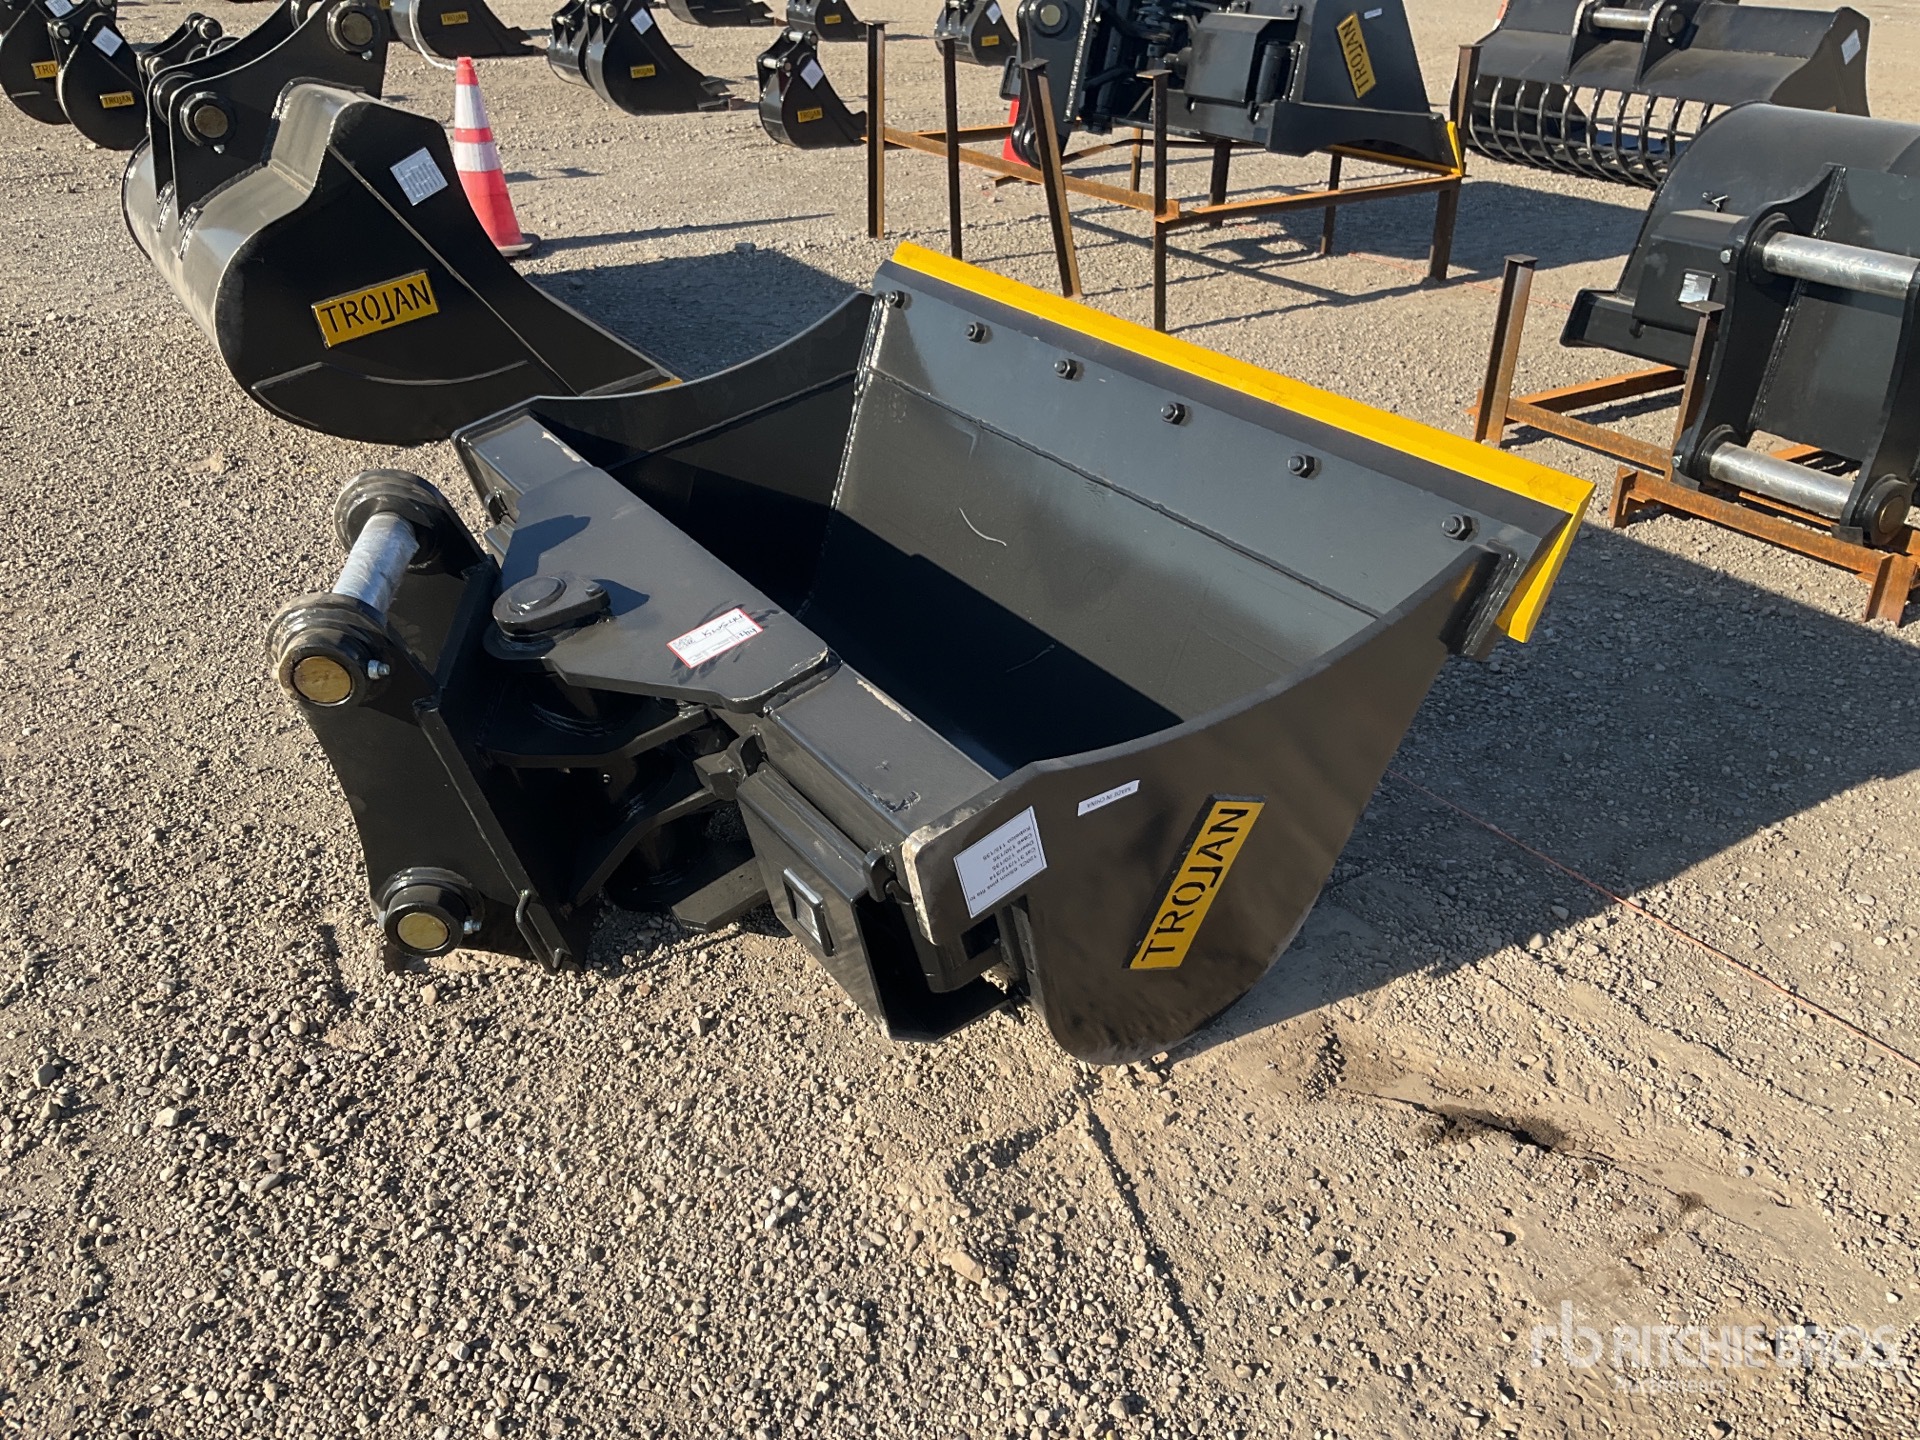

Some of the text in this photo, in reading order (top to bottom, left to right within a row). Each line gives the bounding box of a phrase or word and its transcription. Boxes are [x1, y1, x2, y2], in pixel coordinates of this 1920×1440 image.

[1342, 20, 1369, 93] TROJAN
[103, 96, 133, 106] TROJAN
[321, 280, 431, 333] TROJAN
[1141, 808, 1250, 962] TROJAN
